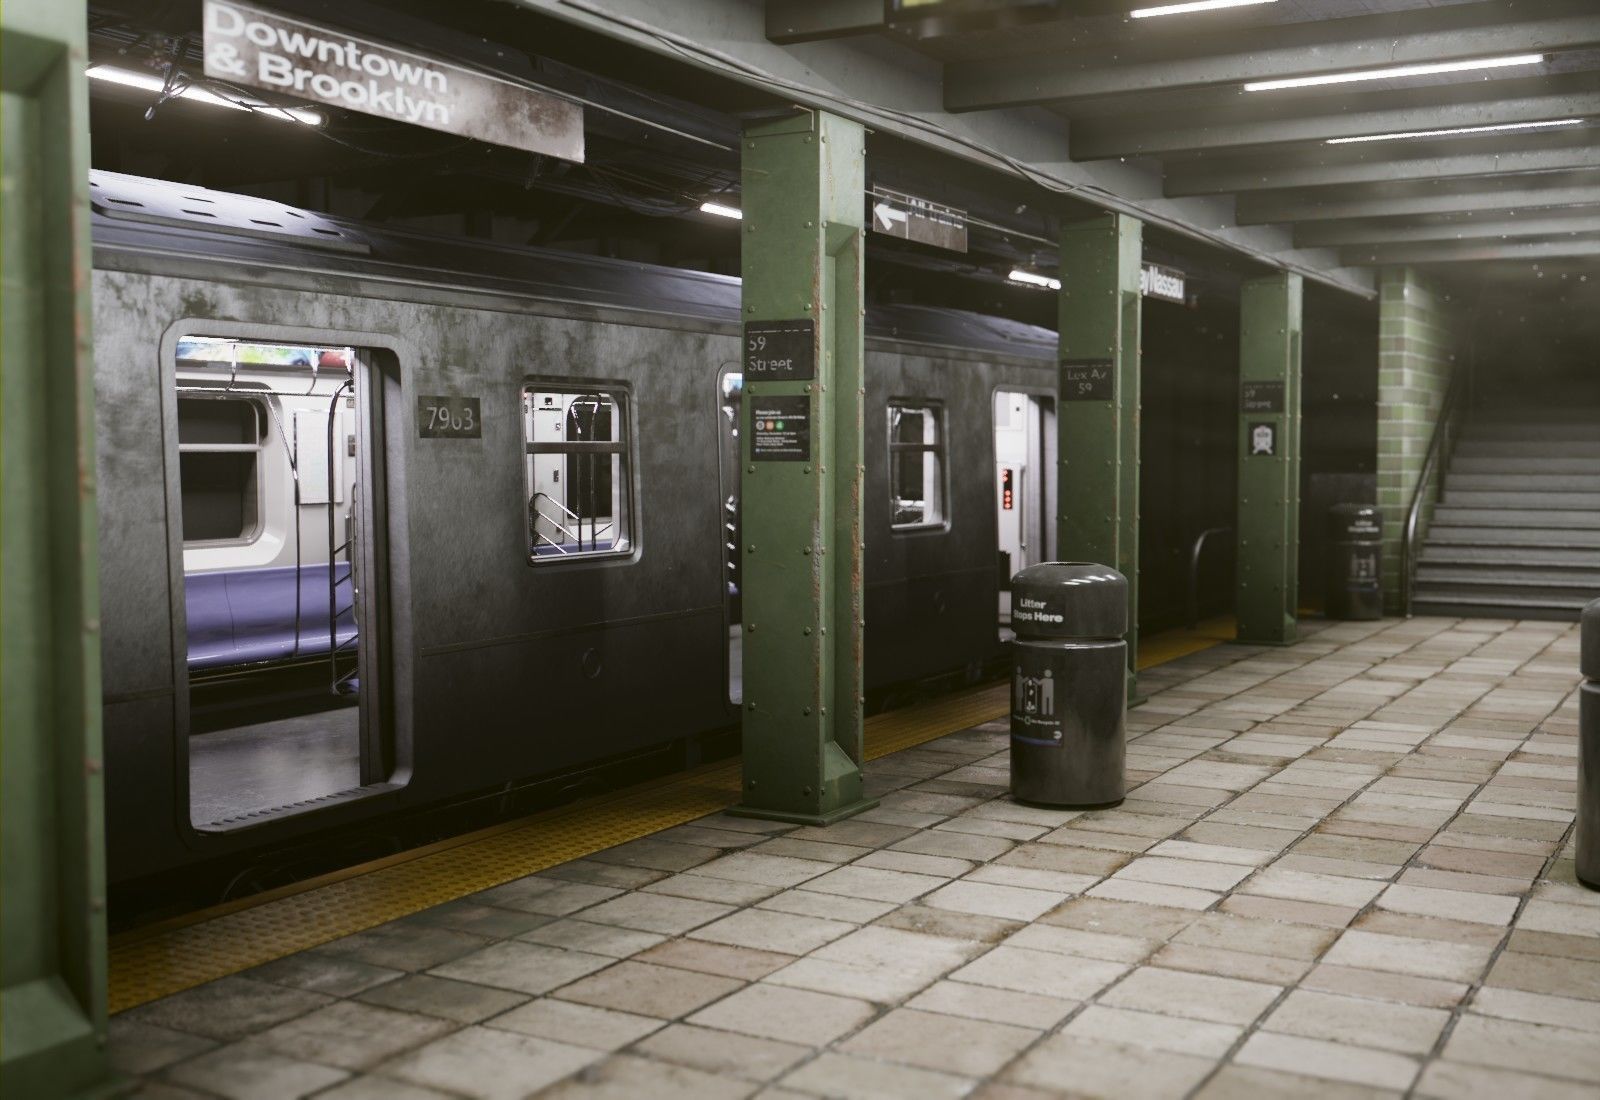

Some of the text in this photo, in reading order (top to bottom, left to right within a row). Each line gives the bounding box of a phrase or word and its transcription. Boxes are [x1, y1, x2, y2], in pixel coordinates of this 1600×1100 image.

[206, 3, 448, 94] Downtown
[207, 42, 449, 125] & Brooklyn
[748, 356, 793, 371] Street
[1020, 597, 1047, 609] Litter
[1034, 611, 1064, 623] Here
